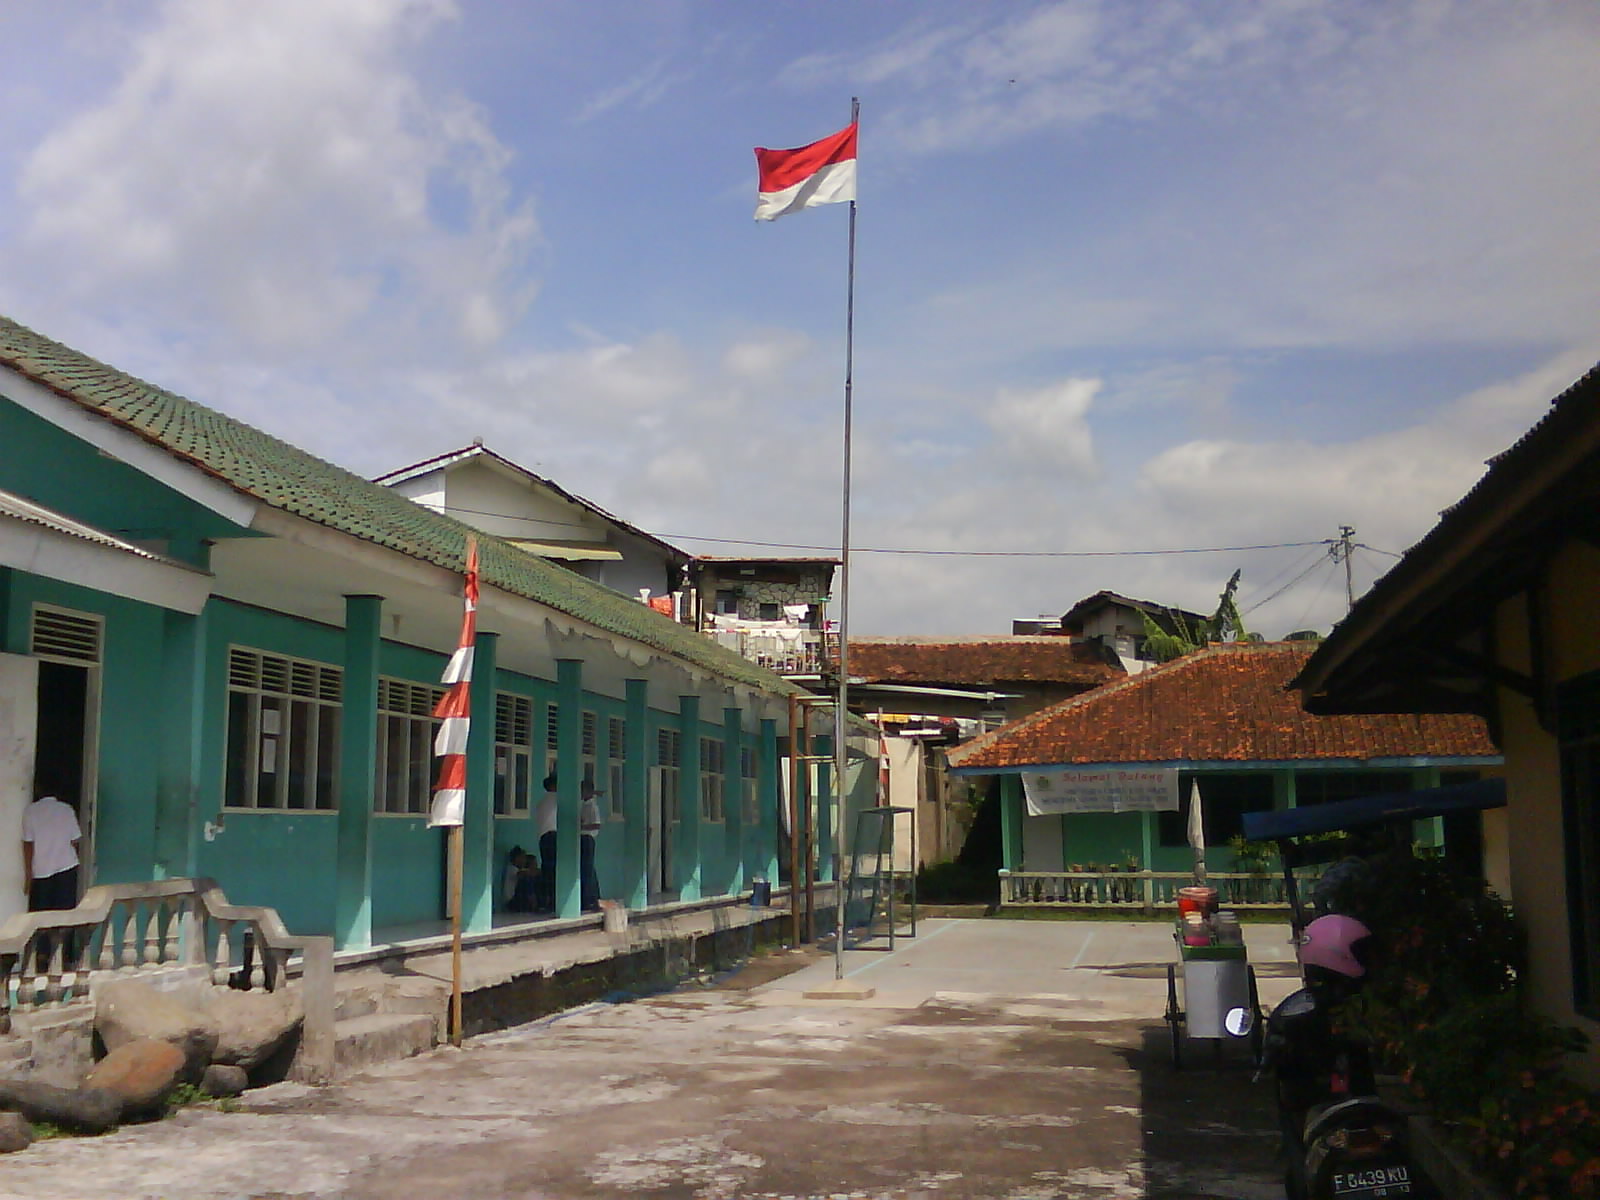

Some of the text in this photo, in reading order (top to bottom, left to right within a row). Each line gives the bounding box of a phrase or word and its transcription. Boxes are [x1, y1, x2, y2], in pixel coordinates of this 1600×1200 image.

[1063, 771, 1164, 783] Selamat Datang
[1334, 1175, 1344, 1190] F
